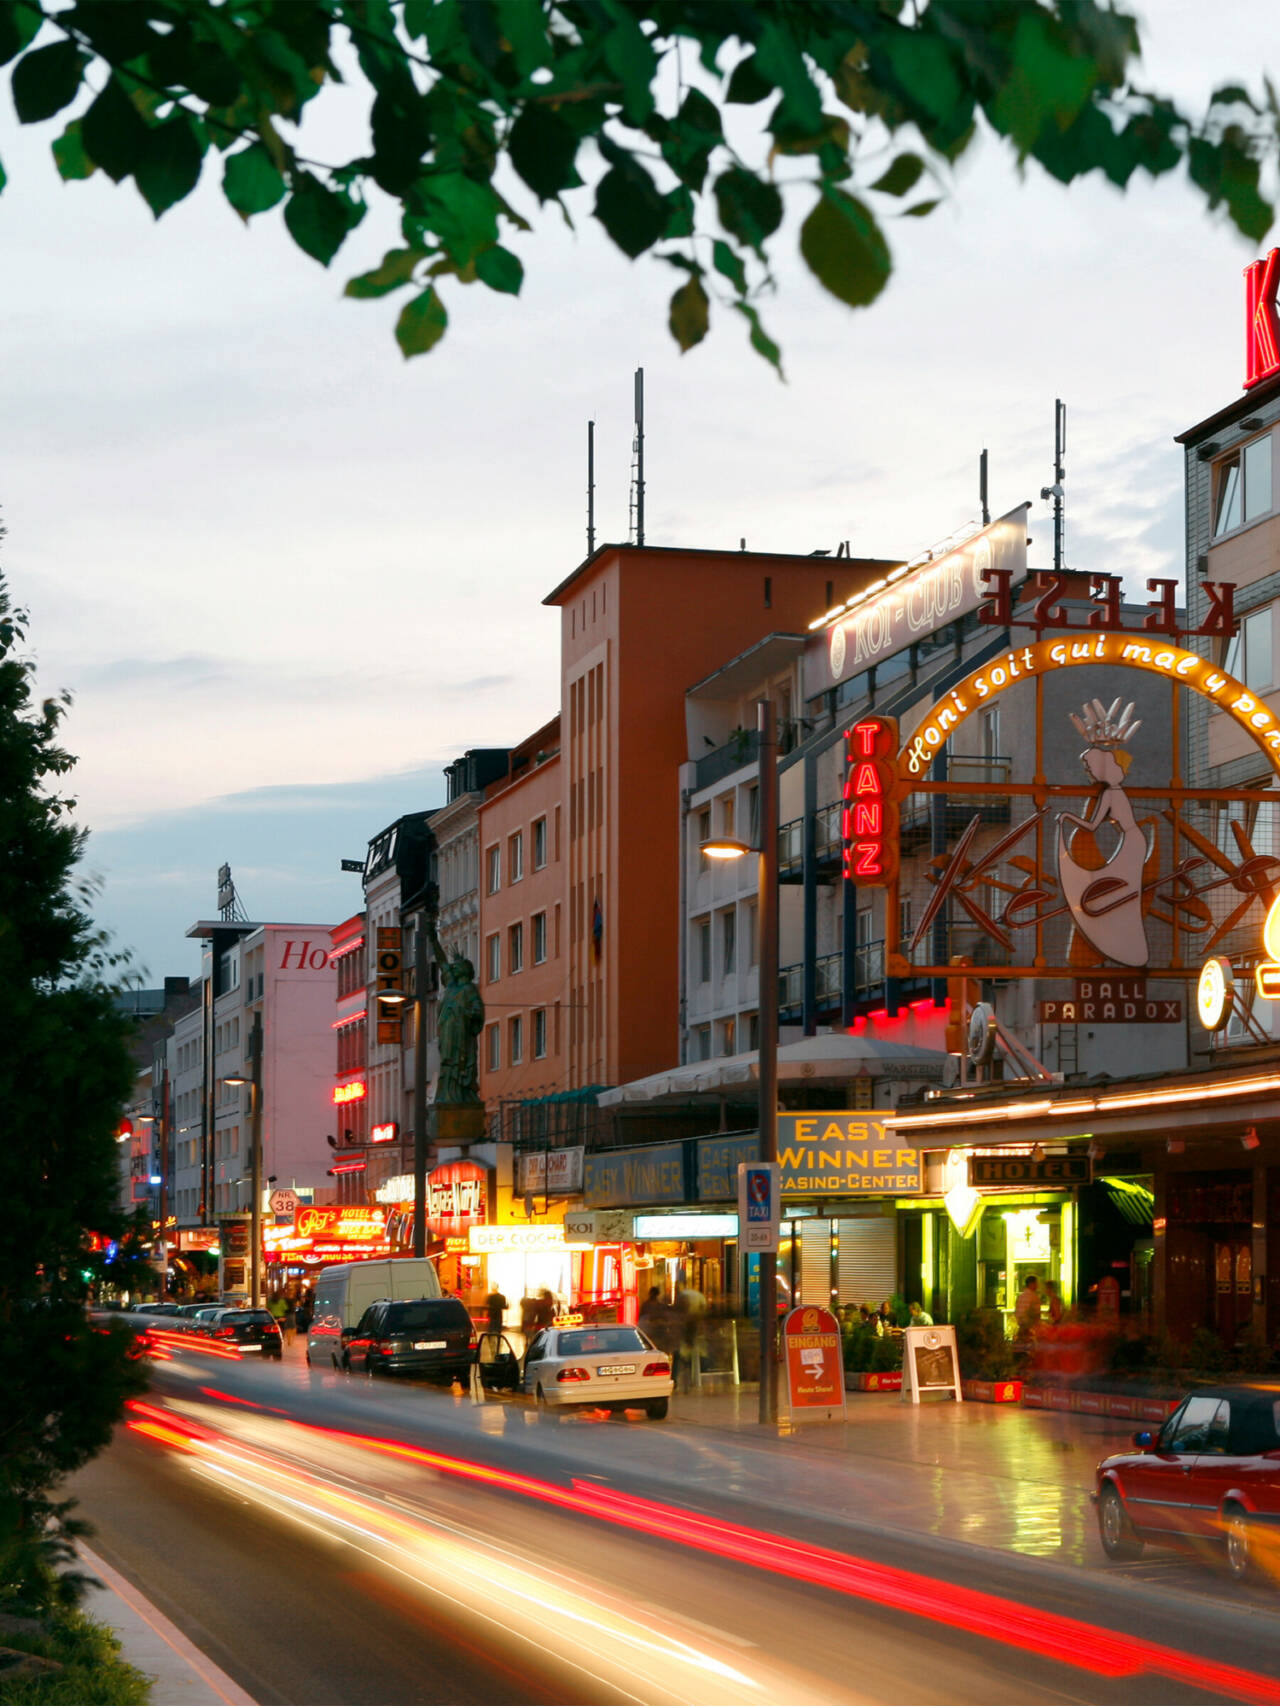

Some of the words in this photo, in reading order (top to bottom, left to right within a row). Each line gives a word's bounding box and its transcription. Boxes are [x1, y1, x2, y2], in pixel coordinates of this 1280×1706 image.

[907, 691, 967, 773] Honi
[974, 648, 1034, 697] soit
[1122, 643, 1199, 675] mal
[1204, 674, 1224, 695] y
[857, 722, 882, 875] TANZ
[1080, 983, 1144, 999] BALL
[1045, 1003, 1178, 1019] PARADOX
[795, 1119, 888, 1142] EASY
[776, 1147, 918, 1169] WINNER
[624, 1159, 683, 1195] WINNER
[983, 1162, 1076, 1180] HOTEL
[702, 1172, 738, 1195] CENT
[780, 1173, 919, 1190] ASINO-CENTER
[275, 1200, 294, 1211] 38
[749, 1206, 768, 1217] TAXI
[567, 1223, 593, 1233] KOI
[788, 1336, 837, 1349] EINGANG
